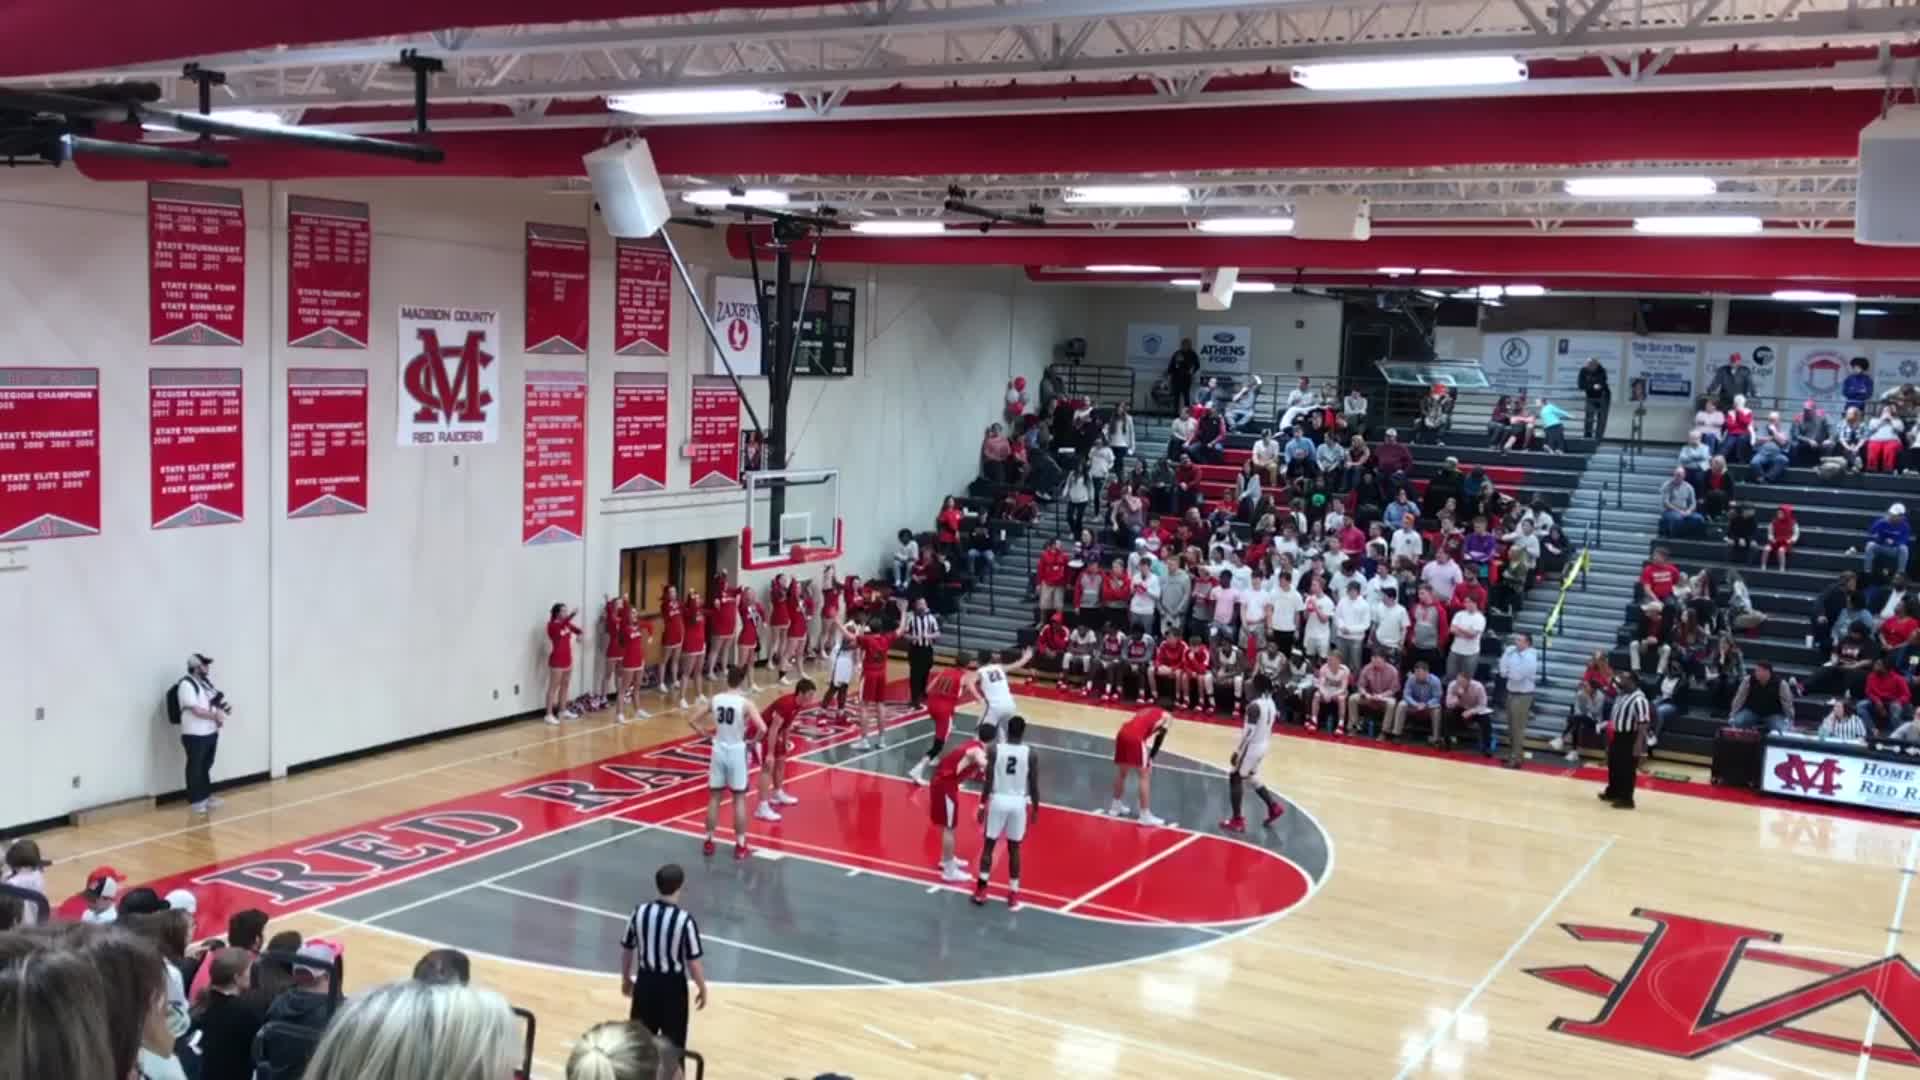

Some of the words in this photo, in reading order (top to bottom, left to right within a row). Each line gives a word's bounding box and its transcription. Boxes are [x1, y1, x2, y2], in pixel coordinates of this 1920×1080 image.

[161, 282, 187, 290] STATE
[190, 282, 213, 291] FINAL
[161, 302, 187, 311] STATE
[402, 307, 450, 321] MADISON
[454, 311, 496, 323] COUNTY
[1200, 345, 1246, 356] ATHENS
[1209, 356, 1238, 364] FORD
[37, 391, 93, 400] CHAMPIONS
[0, 431, 27, 440] STATE
[30, 429, 94, 439] TOURNAMENT
[412, 431, 435, 443] RED
[438, 430, 483, 442] RAIDERS
[160, 465, 186, 474] STATE
[1, 473, 31, 482] STATE
[33, 472, 60, 481] ELITE
[62, 470, 91, 479] EIGHT
[716, 705, 735, 725] 30
[1006, 756, 1017, 774] 2
[1861, 762, 1916, 781] HOME
[1860, 780, 1898, 797] RED
[193, 810, 524, 906] RED
